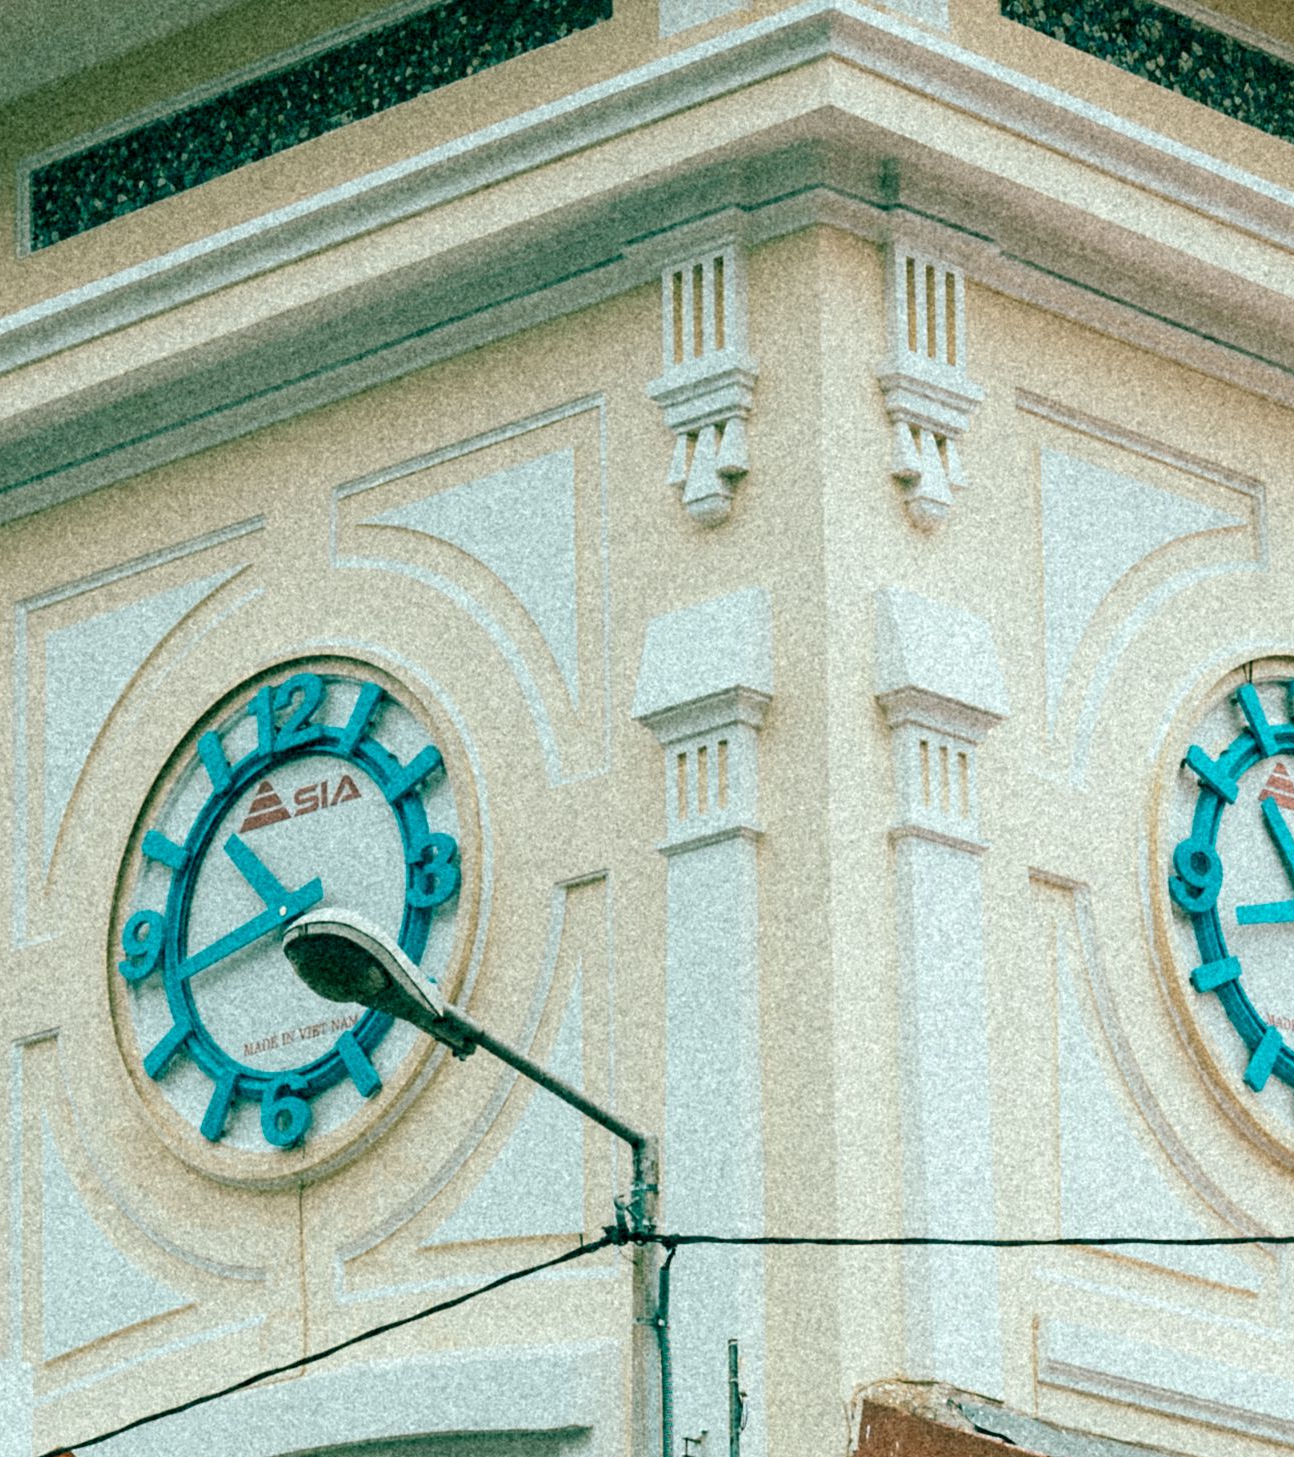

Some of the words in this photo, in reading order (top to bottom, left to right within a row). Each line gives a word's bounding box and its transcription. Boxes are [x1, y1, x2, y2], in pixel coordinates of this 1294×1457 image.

[249, 673, 324, 757] 12
[410, 833, 461, 907] 3
[1169, 838, 1223, 912] 9
[119, 909, 164, 981] 9
[262, 1074, 313, 1148] 6
